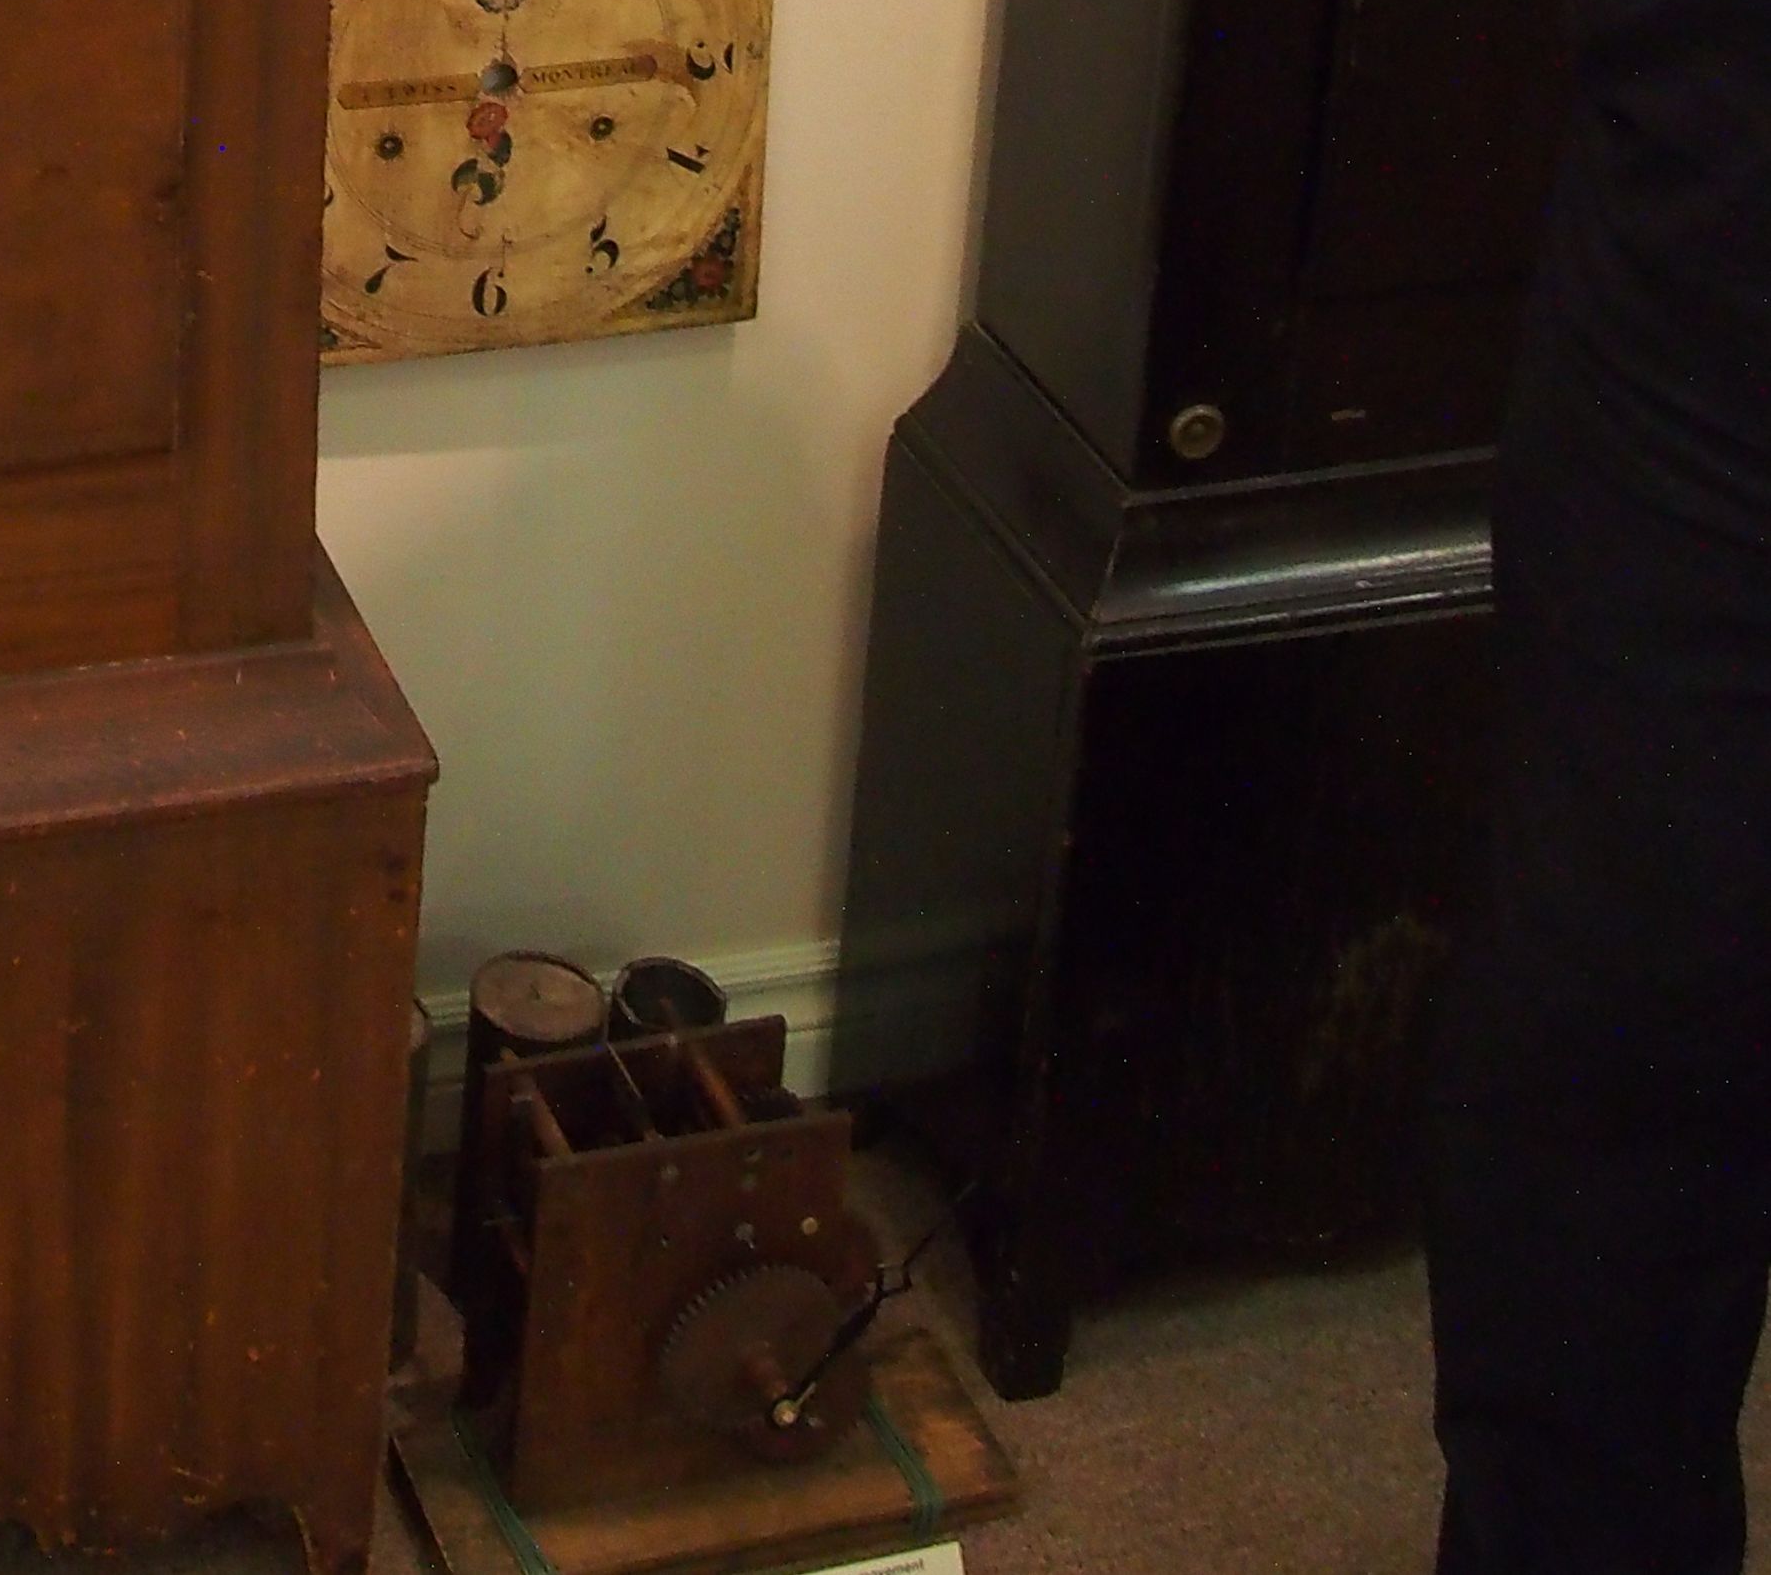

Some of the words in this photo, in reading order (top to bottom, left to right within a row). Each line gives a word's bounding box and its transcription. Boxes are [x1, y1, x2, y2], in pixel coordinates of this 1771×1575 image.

[365, 243, 419, 294] 7
[585, 215, 620, 274] 5
[472, 267, 507, 317] 6
